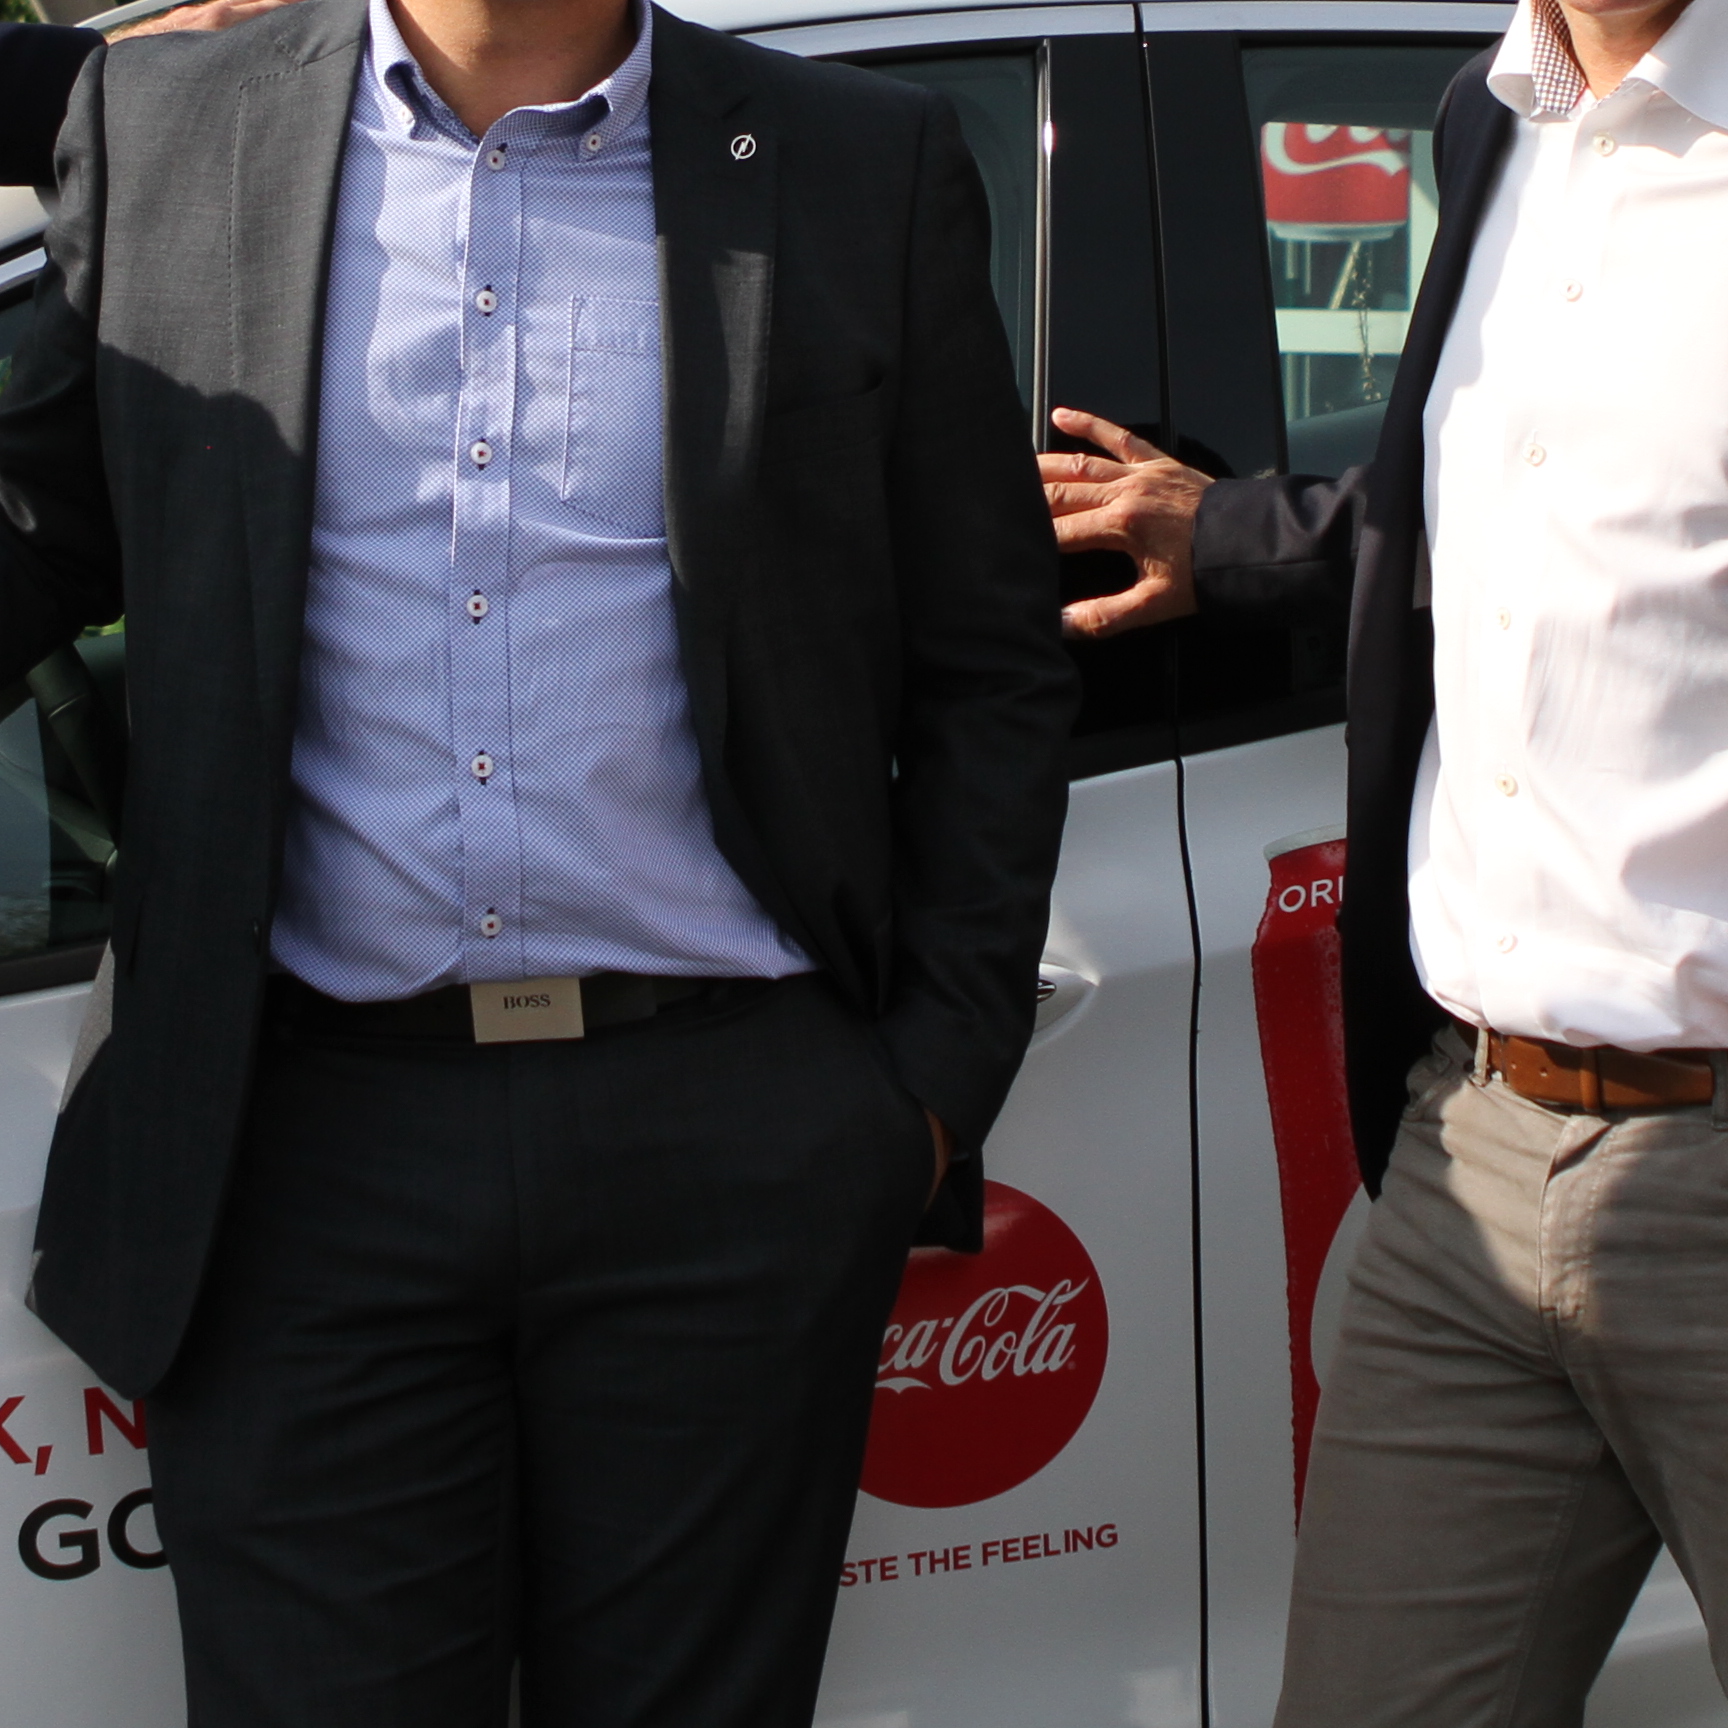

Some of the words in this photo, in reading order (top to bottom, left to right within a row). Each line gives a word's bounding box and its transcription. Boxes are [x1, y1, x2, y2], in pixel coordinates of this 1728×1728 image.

[503, 993, 551, 1010] BOSS
[907, 1544, 973, 1576] THE
[981, 1523, 1119, 1567] FEELING
